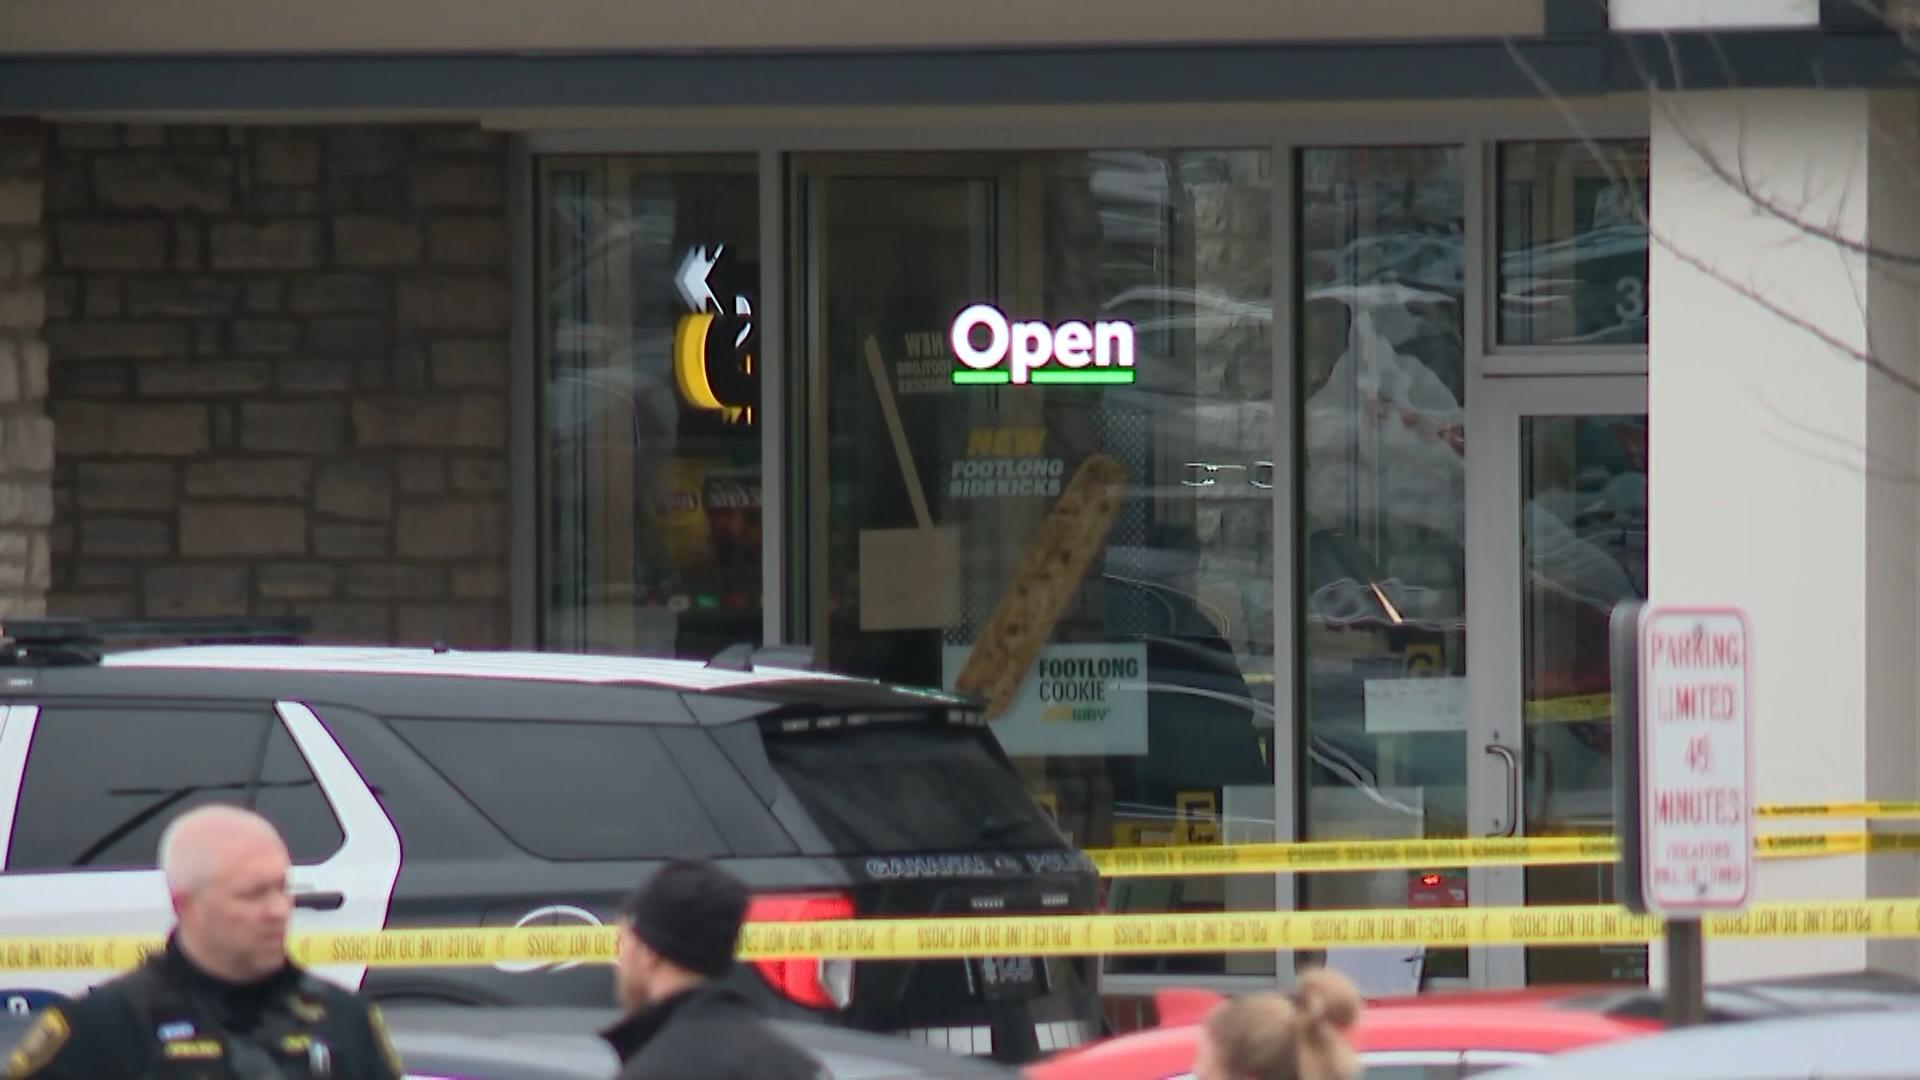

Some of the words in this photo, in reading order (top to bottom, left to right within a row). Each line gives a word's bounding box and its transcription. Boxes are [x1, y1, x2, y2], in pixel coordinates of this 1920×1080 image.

[951, 303, 1136, 385] Open
[967, 427, 1047, 456] NEW
[952, 459, 1063, 478] FOOTLONG
[950, 479, 1062, 498] SIDEKICKS
[1651, 632, 1739, 670] PARKING
[1039, 658, 1138, 679] FOOTLONG
[1039, 680, 1106, 702] COOKIE
[1657, 683, 1735, 722] LIMITED
[1684, 734, 1710, 773] 45
[1654, 790, 1740, 826] MINUTES
[1230, 920, 1268, 943] POLICE
[1311, 917, 1349, 942] CROSS
[1355, 917, 1377, 941] NOT
[1429, 917, 1466, 940] POLICE
[1510, 913, 1548, 937] CROSS
[1553, 913, 1575, 937] NOT
[1579, 912, 1595, 936] DO
[1599, 911, 1623, 936] LINE
[1629, 912, 1666, 936] OLICE
[1754, 910, 1777, 934] NOT
[1782, 909, 1798, 934] DO
[1802, 907, 1827, 933] LINE
[1832, 906, 1871, 933] POLICE
[527, 933, 562, 956] CROSS
[570, 933, 587, 955] NOT
[764, 930, 785, 951] NOT
[838, 928, 875, 951] POLICE
[917, 926, 955, 950] CROSS
[959, 925, 980, 948] NOT
[985, 925, 999, 948] DO
[1004, 923, 1029, 948] LINE
[1034, 923, 1072, 946] POLICE
[1113, 921, 1151, 945] CROSS
[1155, 921, 1177, 944] NOT
[55, 943, 95, 968] POLICE
[332, 937, 369, 961] CROSS
[374, 937, 395, 960] NOT
[398, 936, 415, 959] DO
[420, 935, 443, 957] LINE
[447, 935, 486, 957] POLICE
